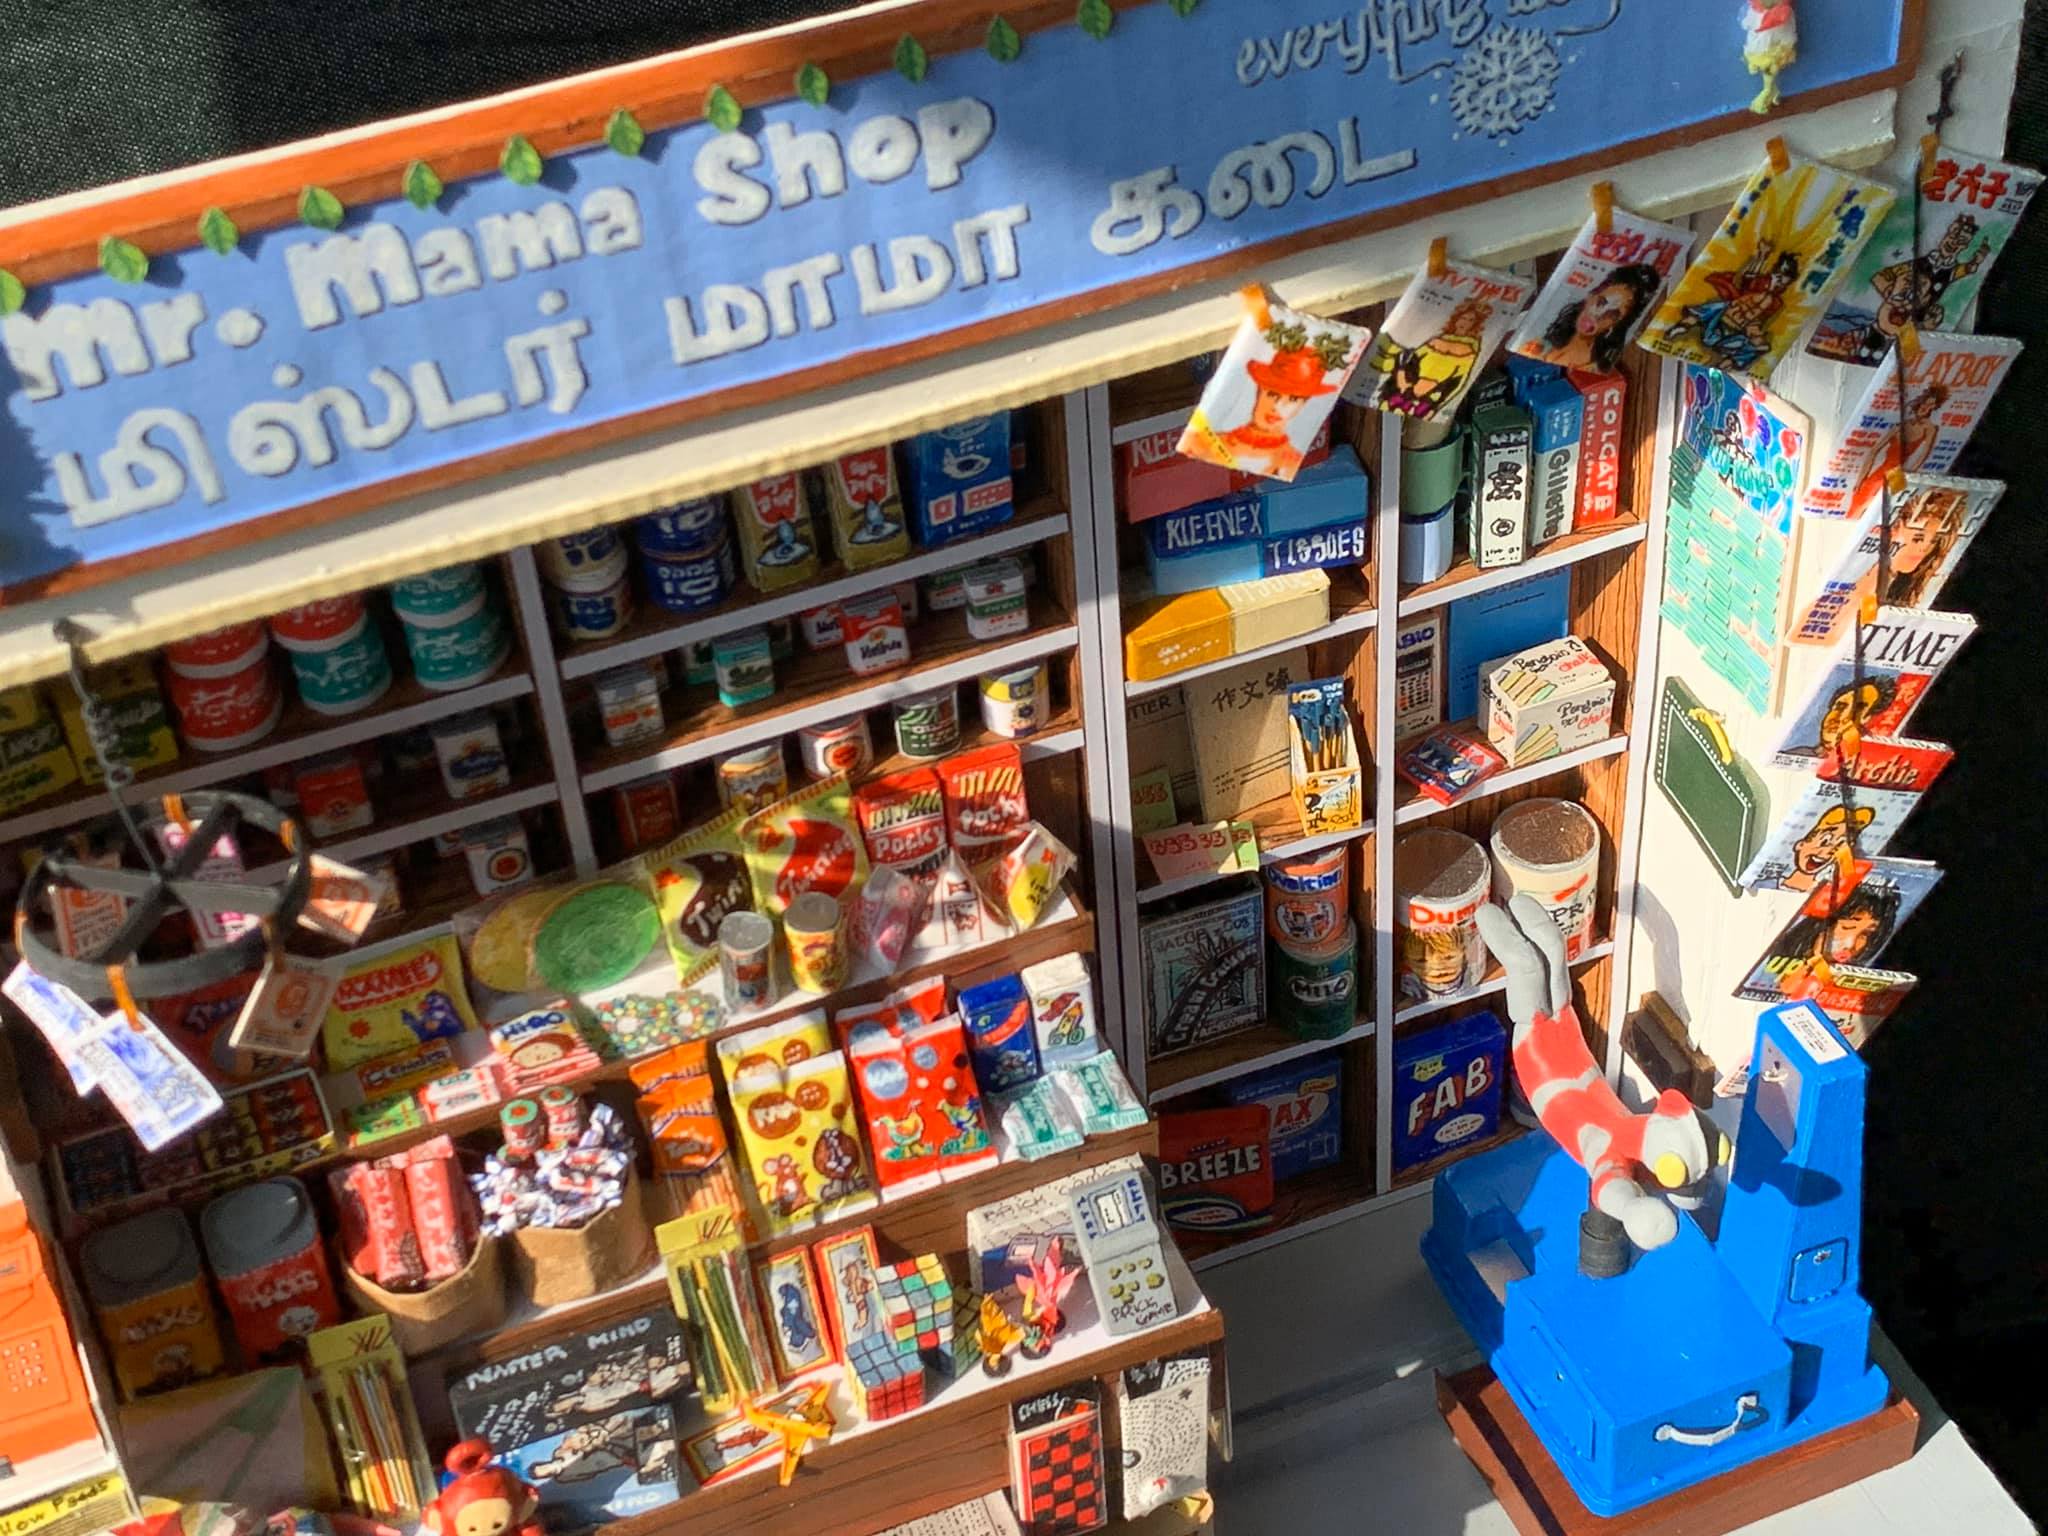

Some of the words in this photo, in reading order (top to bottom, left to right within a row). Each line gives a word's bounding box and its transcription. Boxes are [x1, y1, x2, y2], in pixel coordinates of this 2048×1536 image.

[692, 97, 996, 226] Shop
[52, 288, 592, 529] மிஸ்டர்
[662, 204, 1030, 366] மாமா
[1089, 115, 1418, 257] கடை
[1595, 388, 1620, 512] COLGATE
[1166, 502, 1264, 549] KLEENEX
[1268, 527, 1366, 569] TISSUES
[1860, 623, 1960, 669] TIME
[1841, 754, 1920, 786] Archie
[875, 823, 946, 860] Pocky
[1407, 1056, 1492, 1137] FAB
[1160, 1144, 1262, 1190] BREEZE
[465, 1345, 569, 1391] MASTER
[587, 1318, 651, 1349] MIND
